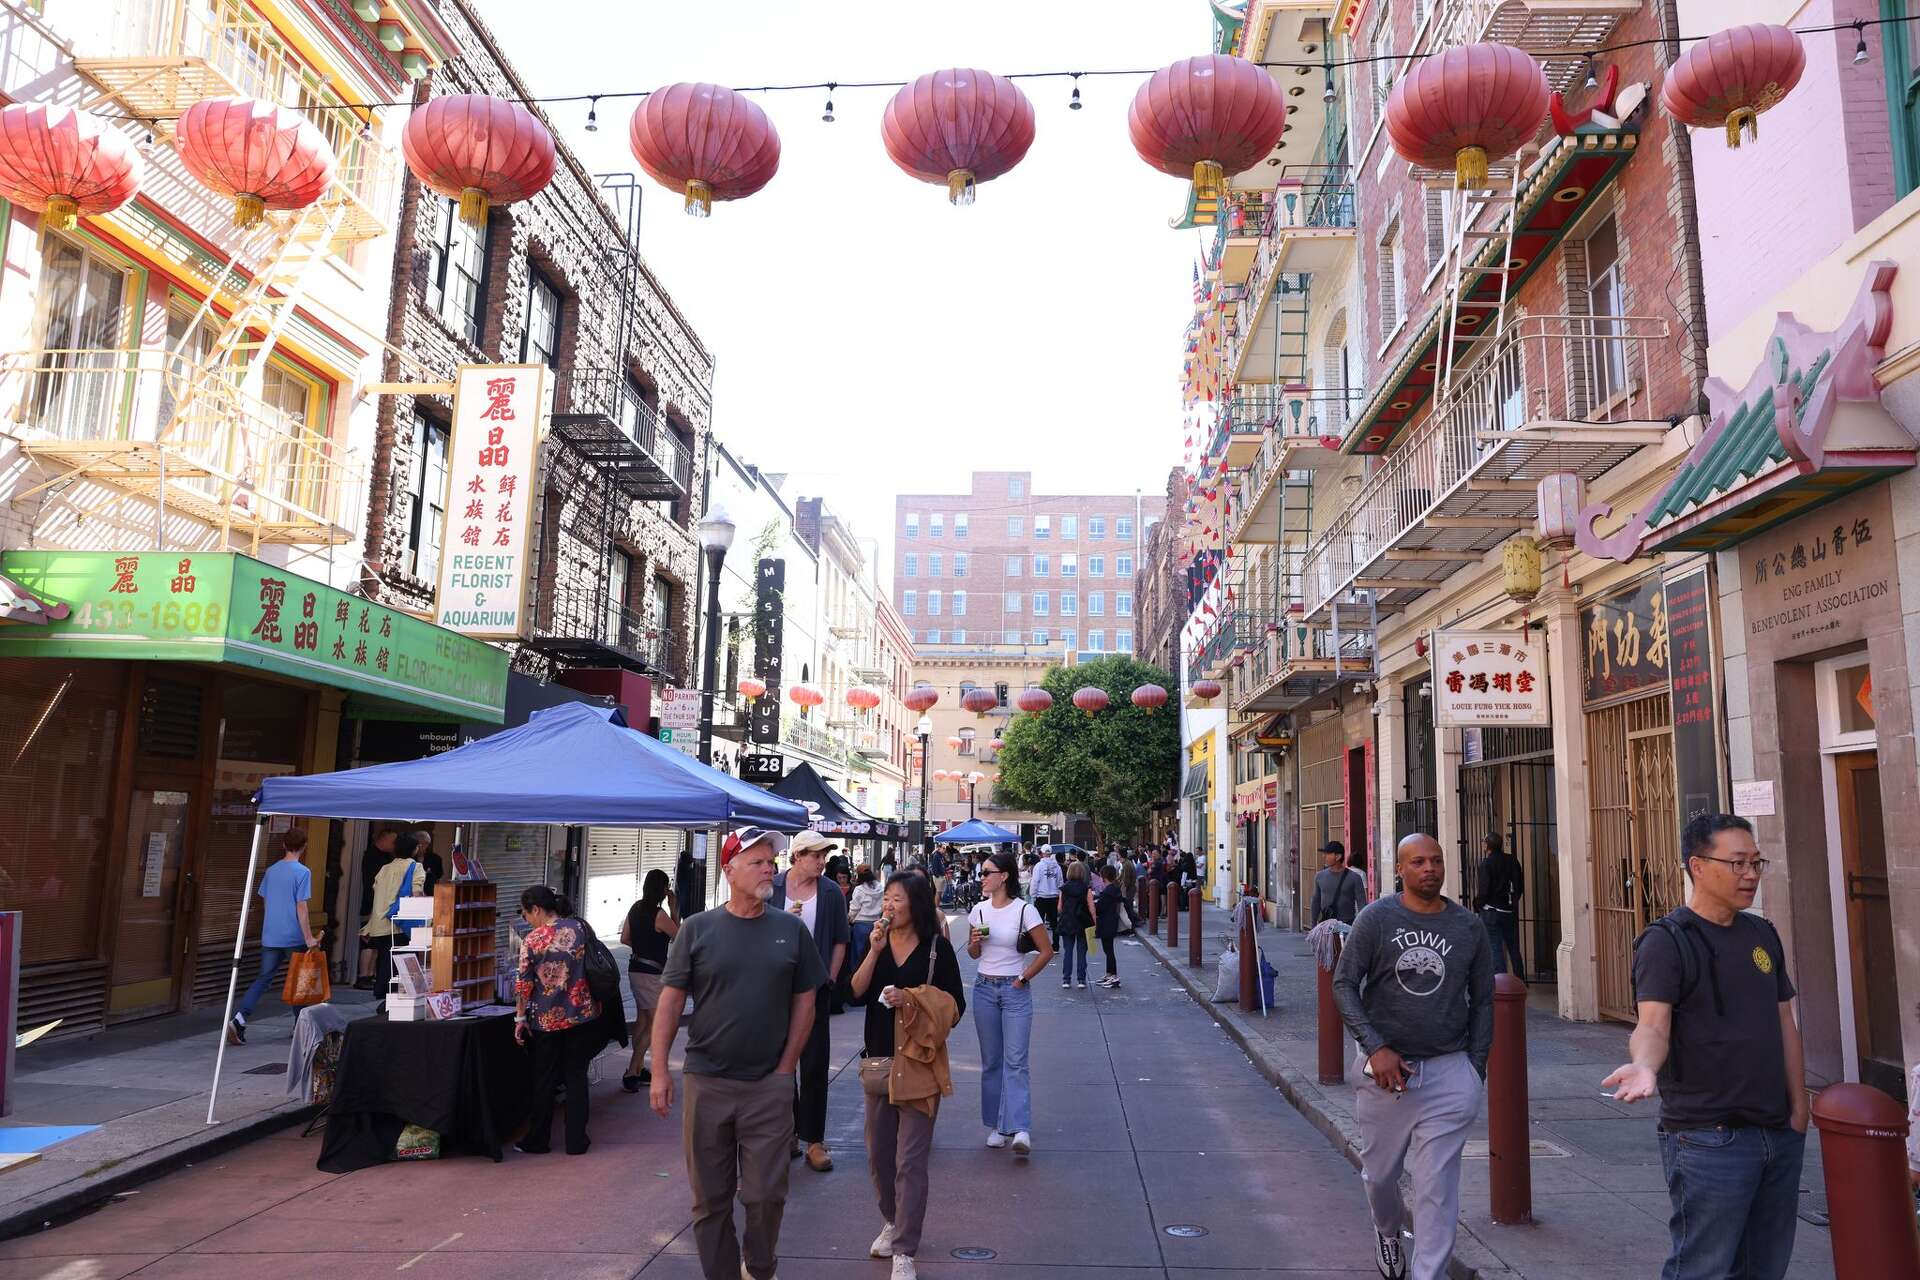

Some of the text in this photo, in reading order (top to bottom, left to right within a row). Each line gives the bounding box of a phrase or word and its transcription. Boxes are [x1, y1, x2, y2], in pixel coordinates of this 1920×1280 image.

[478, 377, 517, 468] 麗晶
[493, 474, 517, 546] 鮮花店
[453, 555, 514, 570] REGENT
[109, 556, 197, 594] 麗晶
[451, 573, 513, 589] FLORIST
[1783, 569, 1842, 601] ENG FAMILY
[475, 592, 487, 607] &
[1752, 579, 1889, 634] BENEVOLENT ASSOCIATION
[251, 577, 319, 652] 麗晶
[442, 611, 516, 627] AQUARIUM
[763, 567, 779, 667] MSTER
[663, 689, 673, 700] NO
[420, 733, 456, 741] unbound
[661, 732, 670, 742] 2
[759, 757, 780, 772] 28
[1392, 930, 1452, 957] TOWN
